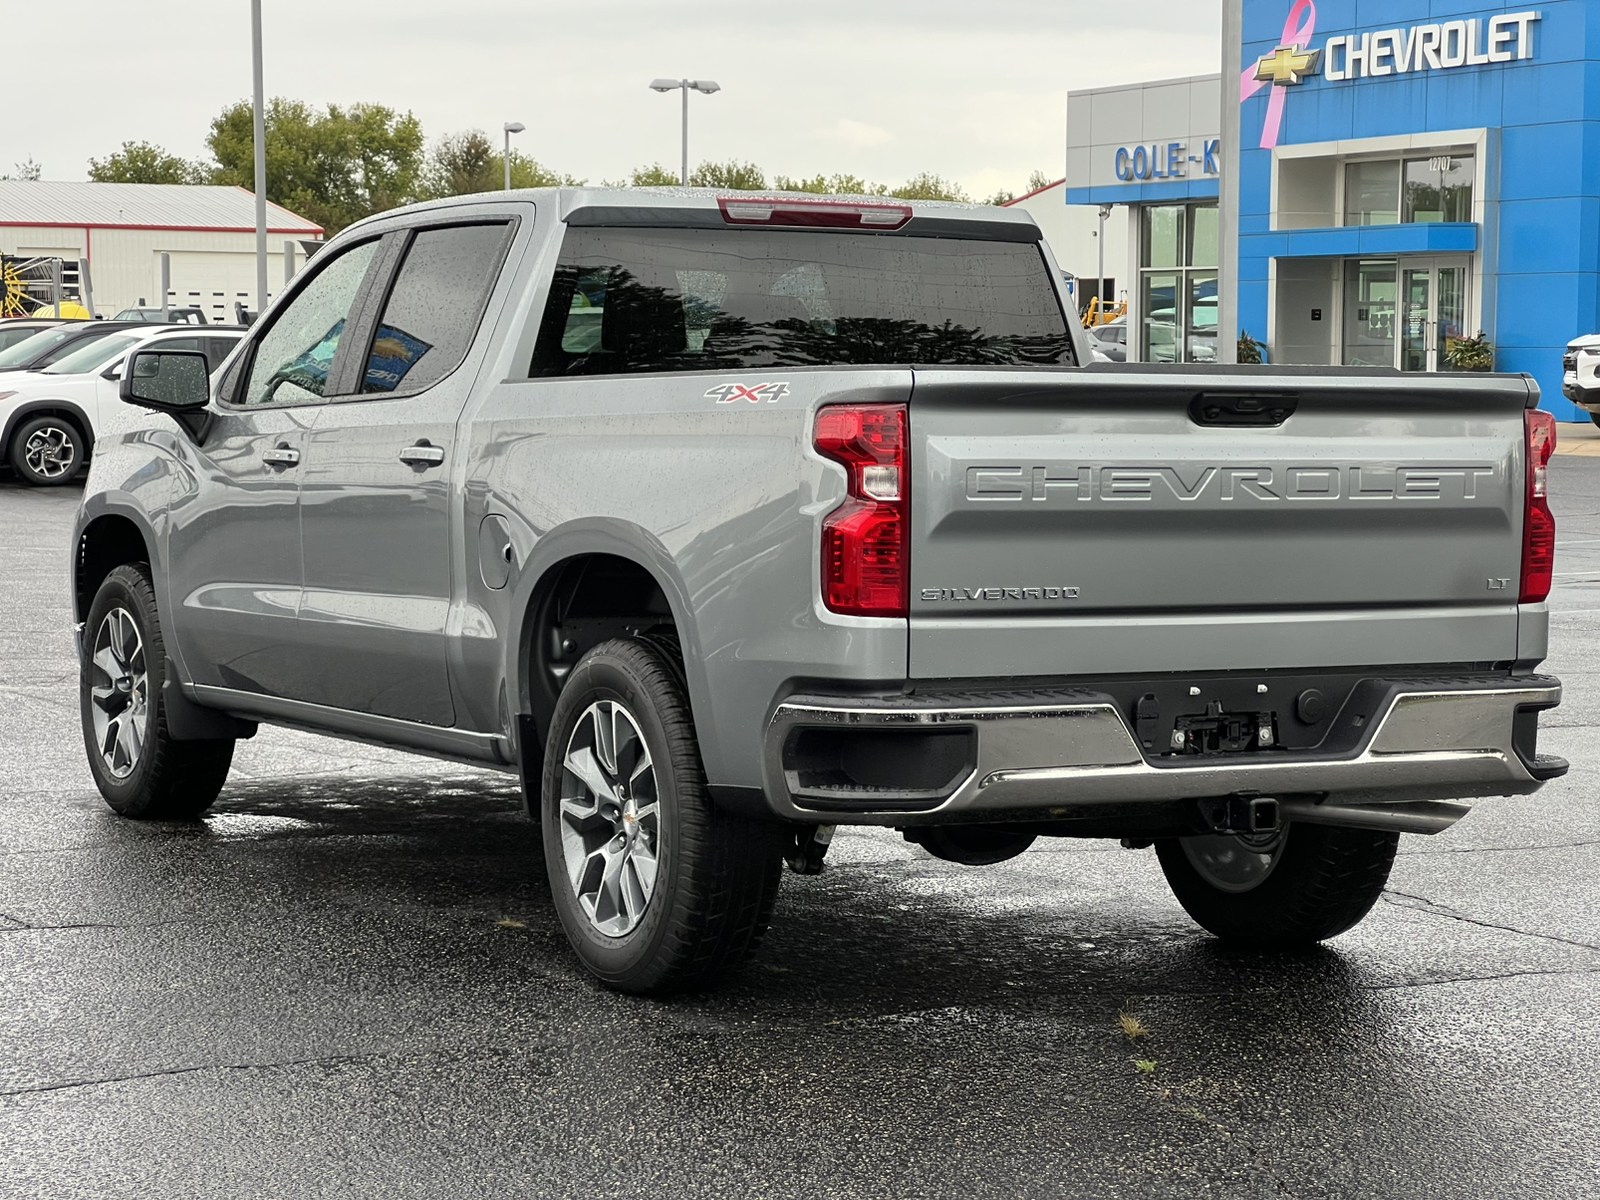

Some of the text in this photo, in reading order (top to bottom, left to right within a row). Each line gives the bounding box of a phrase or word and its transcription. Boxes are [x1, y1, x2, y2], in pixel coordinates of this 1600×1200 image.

[1325, 10, 1540, 81] CHEVROLET
[1429, 156, 1451, 172] 12707
[966, 466, 1494, 501] CHEVROLET
[1487, 577, 1511, 590] LT
[921, 586, 1080, 601] SILVERADO
